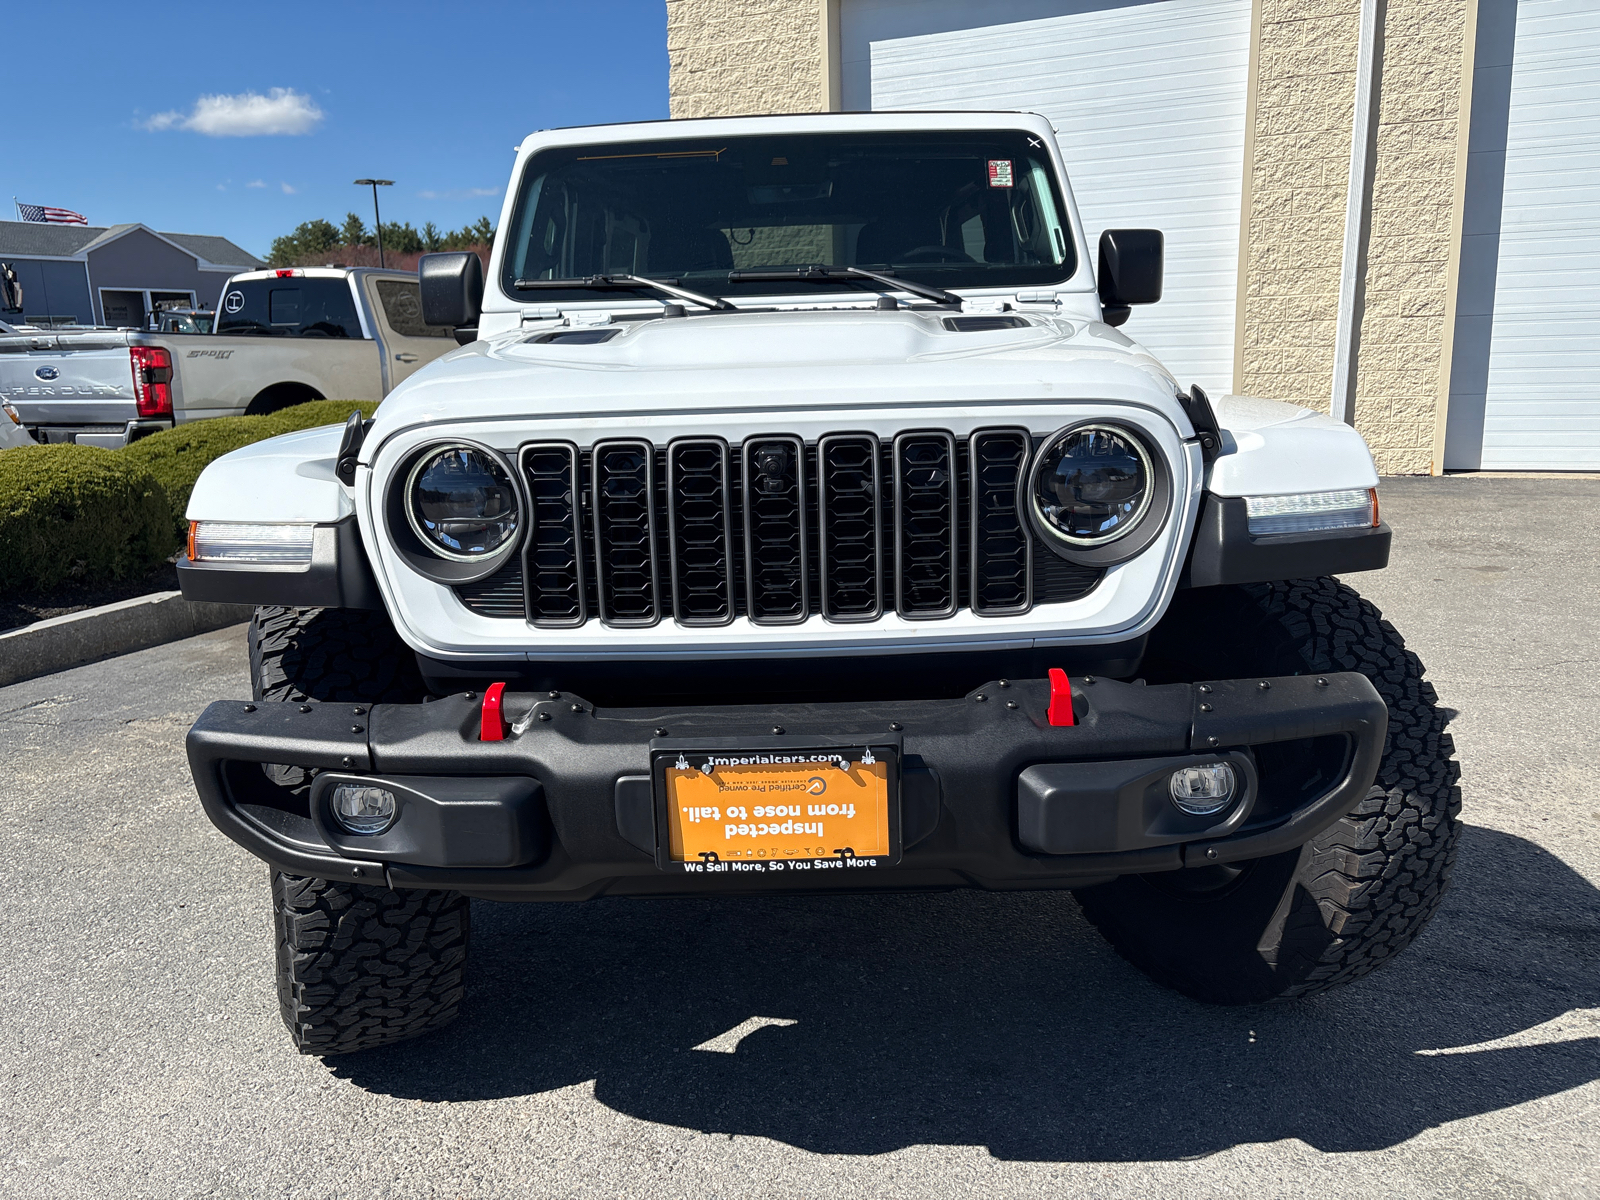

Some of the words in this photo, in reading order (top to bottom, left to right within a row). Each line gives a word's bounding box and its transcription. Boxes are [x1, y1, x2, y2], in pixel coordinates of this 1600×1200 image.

[61, 385, 124, 396] DUTY
[707, 753, 843, 767] Imperialcars.com
[718, 784, 766, 794] Pre-owned
[768, 783, 807, 793] Certified
[682, 806, 721, 823] tail.
[726, 806, 748, 821] to
[753, 804, 801, 818] nose
[807, 803, 856, 819] from
[724, 819, 824, 839] Inspected
[683, 862, 704, 873] We
[706, 861, 729, 872] Sell
[732, 860, 766, 873] More,
[769, 860, 785, 871] So
[787, 859, 811, 871] You
[815, 858, 844, 869] Save
[846, 857, 877, 868] More
